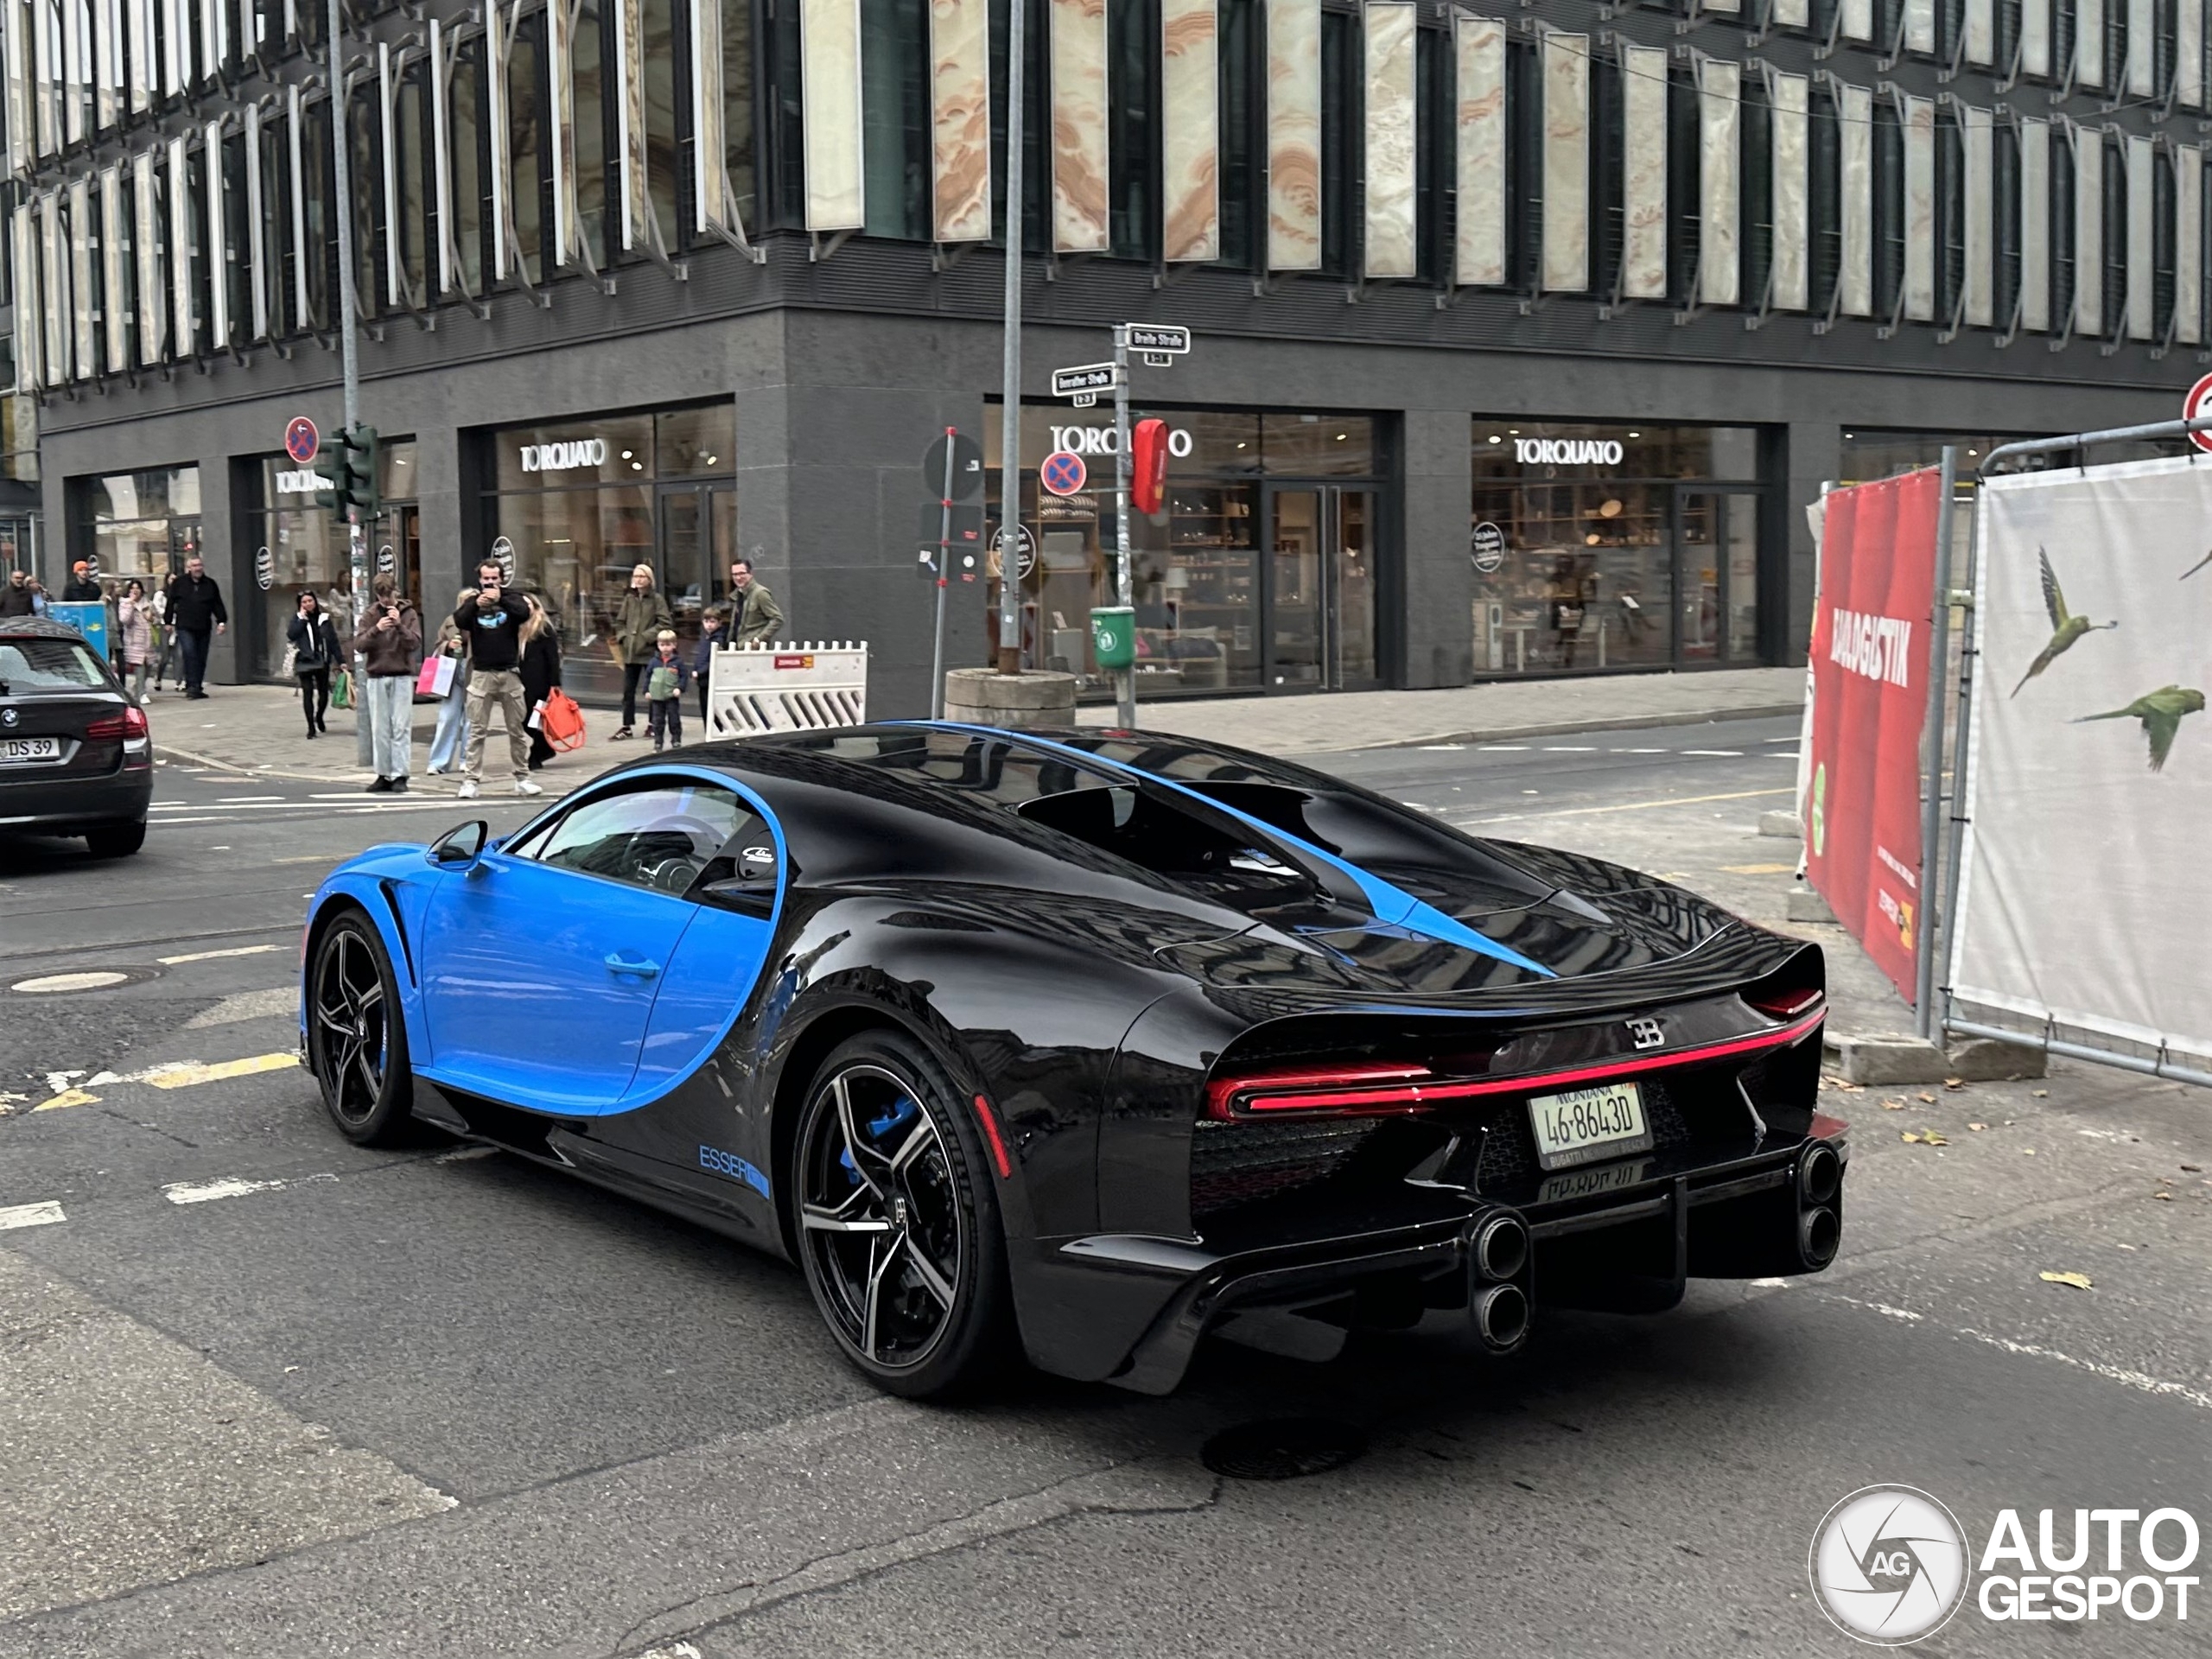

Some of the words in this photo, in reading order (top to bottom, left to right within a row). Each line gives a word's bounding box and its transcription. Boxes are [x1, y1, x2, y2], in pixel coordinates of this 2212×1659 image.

[519, 438, 605, 472] TORQUATO
[1514, 438, 1624, 465] TORQUATO
[8, 741, 29, 756] DS
[33, 740, 52, 755] 39
[1555, 1086, 1614, 1105] MONTANA
[1549, 1151, 1583, 1167] BUGATTI
